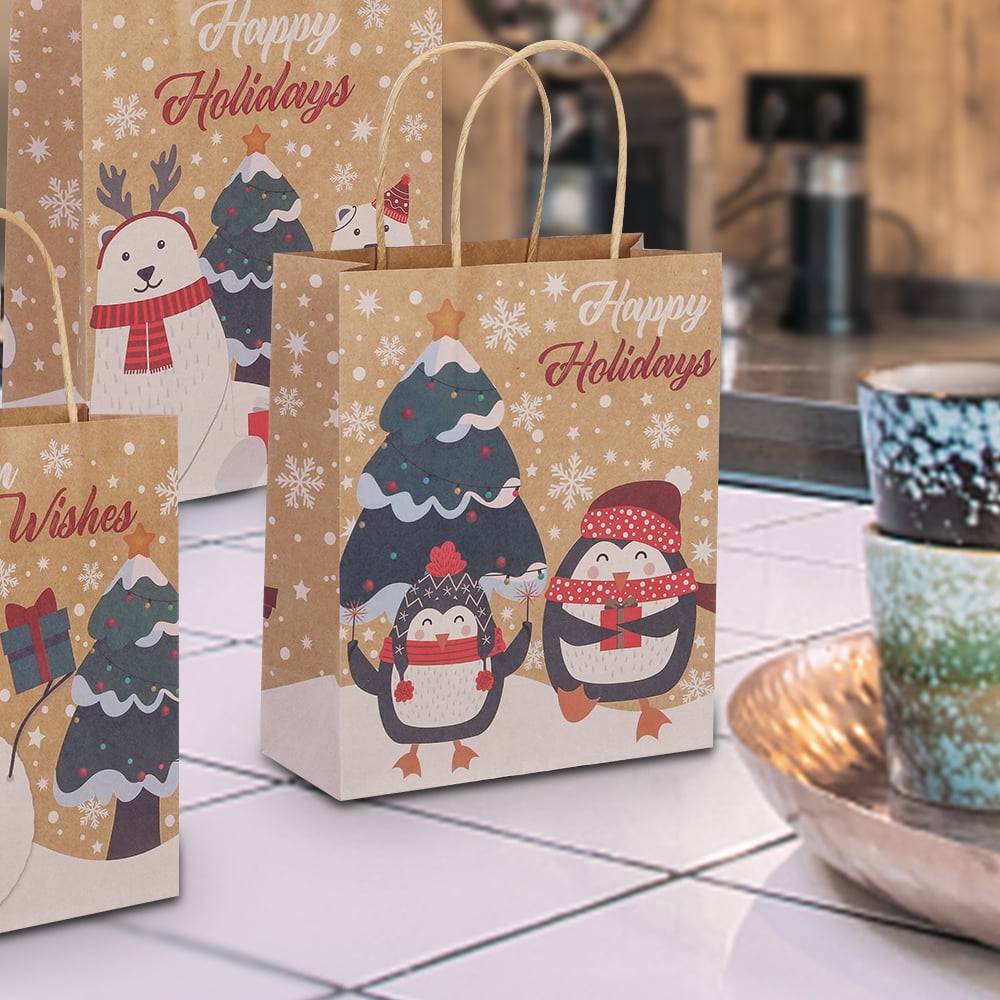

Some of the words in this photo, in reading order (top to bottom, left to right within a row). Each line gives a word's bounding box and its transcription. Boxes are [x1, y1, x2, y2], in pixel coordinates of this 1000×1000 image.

[154, 61, 356, 131] Holidays
[571, 279, 711, 338] Happy
[538, 336, 717, 393] Holidays
